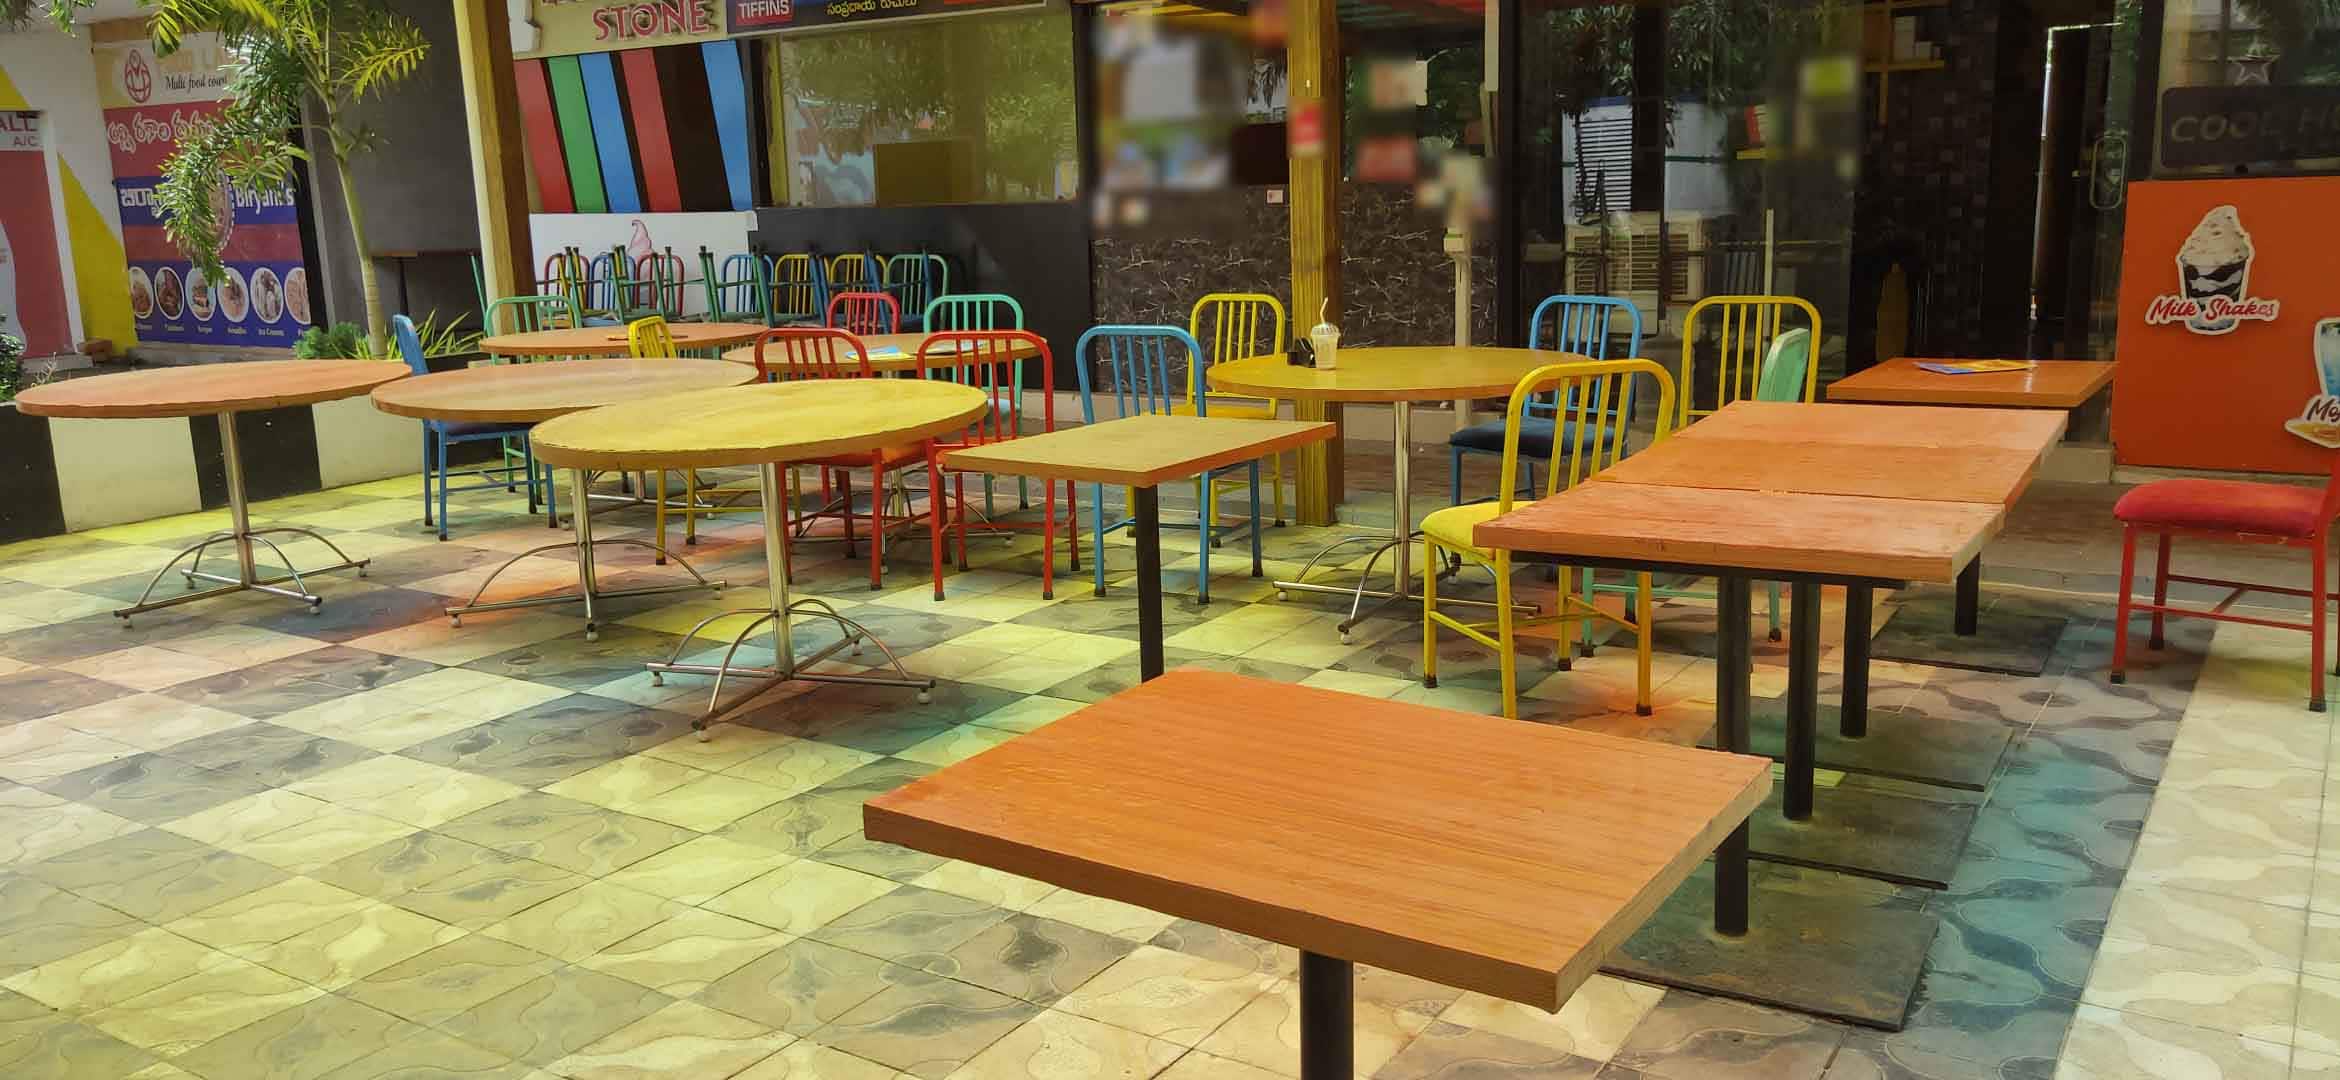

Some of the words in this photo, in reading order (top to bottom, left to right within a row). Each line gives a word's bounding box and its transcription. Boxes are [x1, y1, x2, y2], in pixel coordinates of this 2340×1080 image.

[738, 0, 790, 19] TIFFINS
[592, 0, 710, 41] STONE
[188, 73, 206, 93] food
[2150, 298, 2198, 321] Milk
[2205, 298, 2275, 321] Shakes
